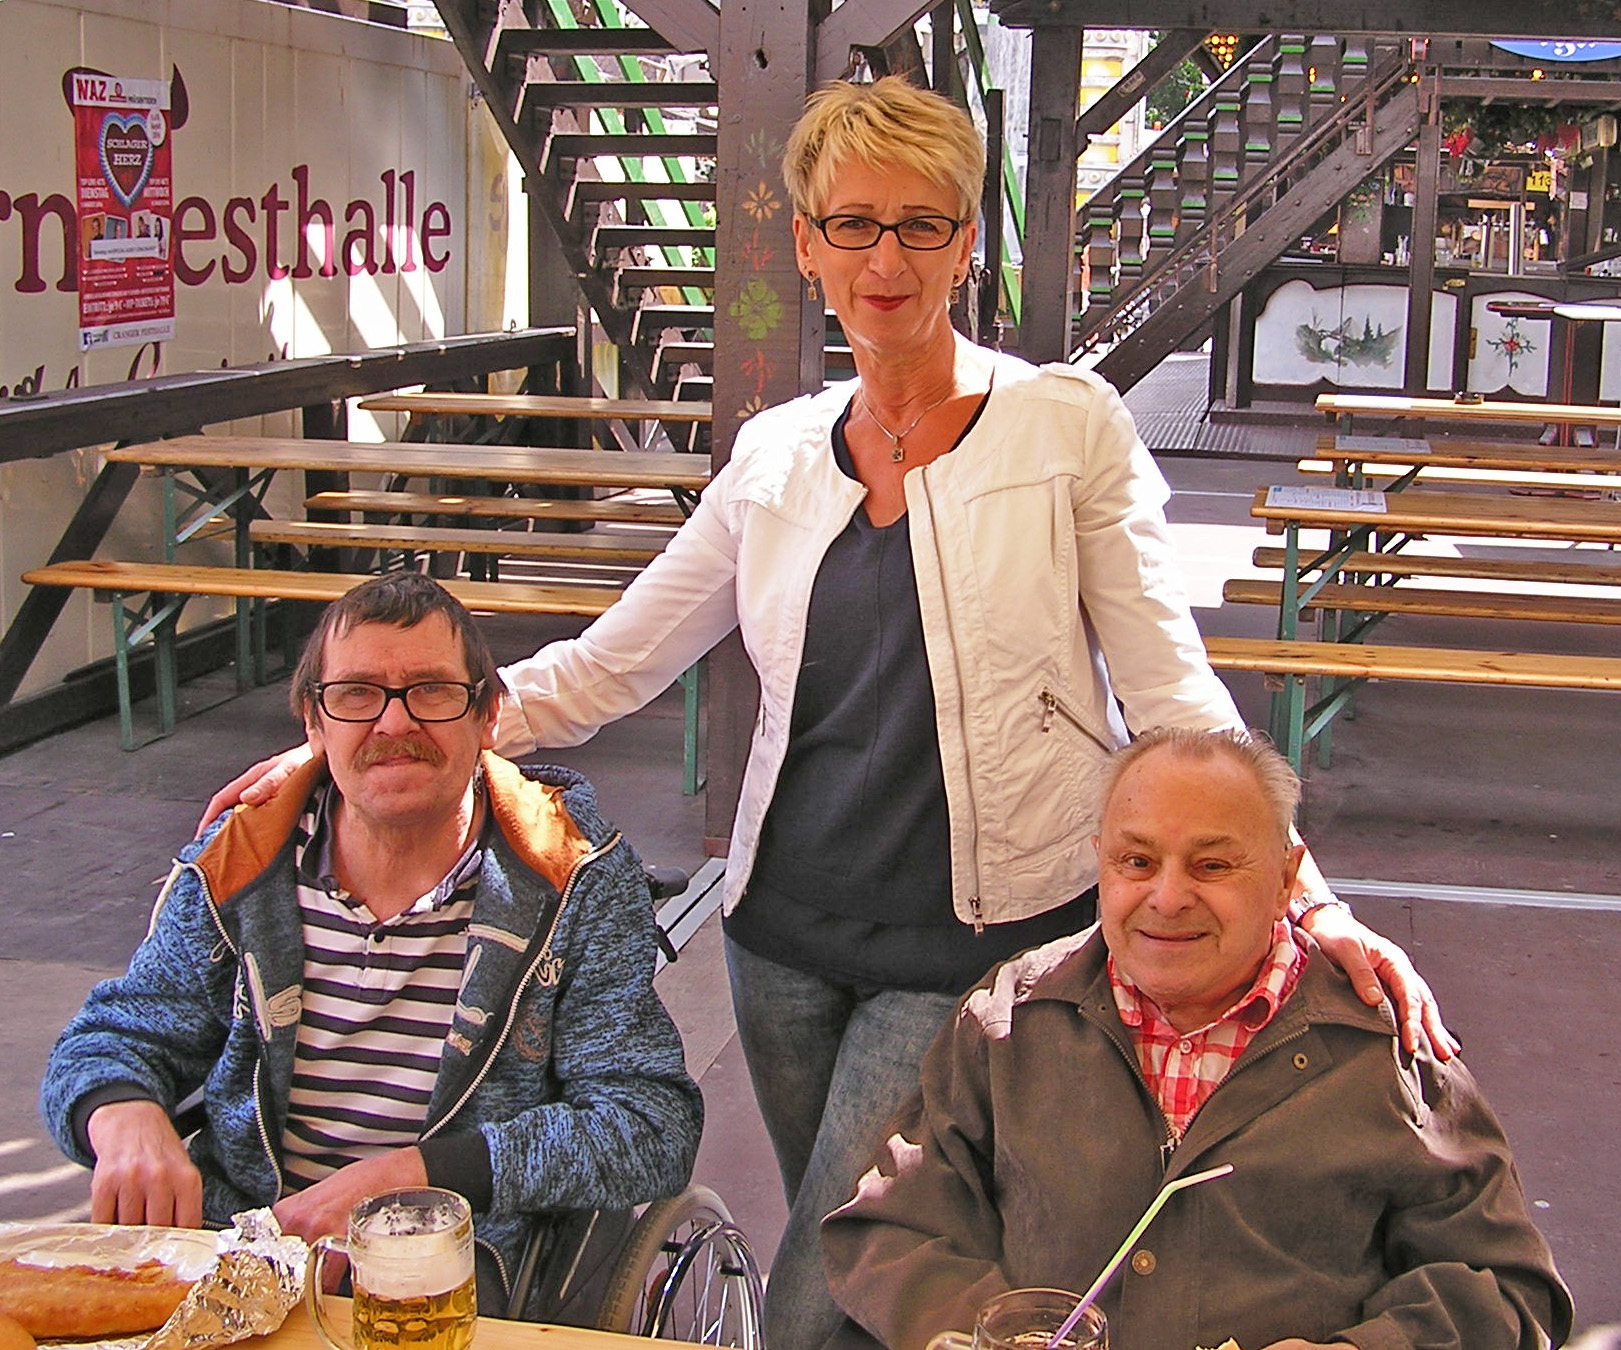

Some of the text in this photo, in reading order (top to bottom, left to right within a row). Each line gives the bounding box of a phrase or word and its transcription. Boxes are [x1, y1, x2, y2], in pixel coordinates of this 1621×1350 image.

[76, 79, 106, 101] WAZ
[106, 138, 148, 149] SCHLAGER
[114, 154, 142, 166] HERZ
